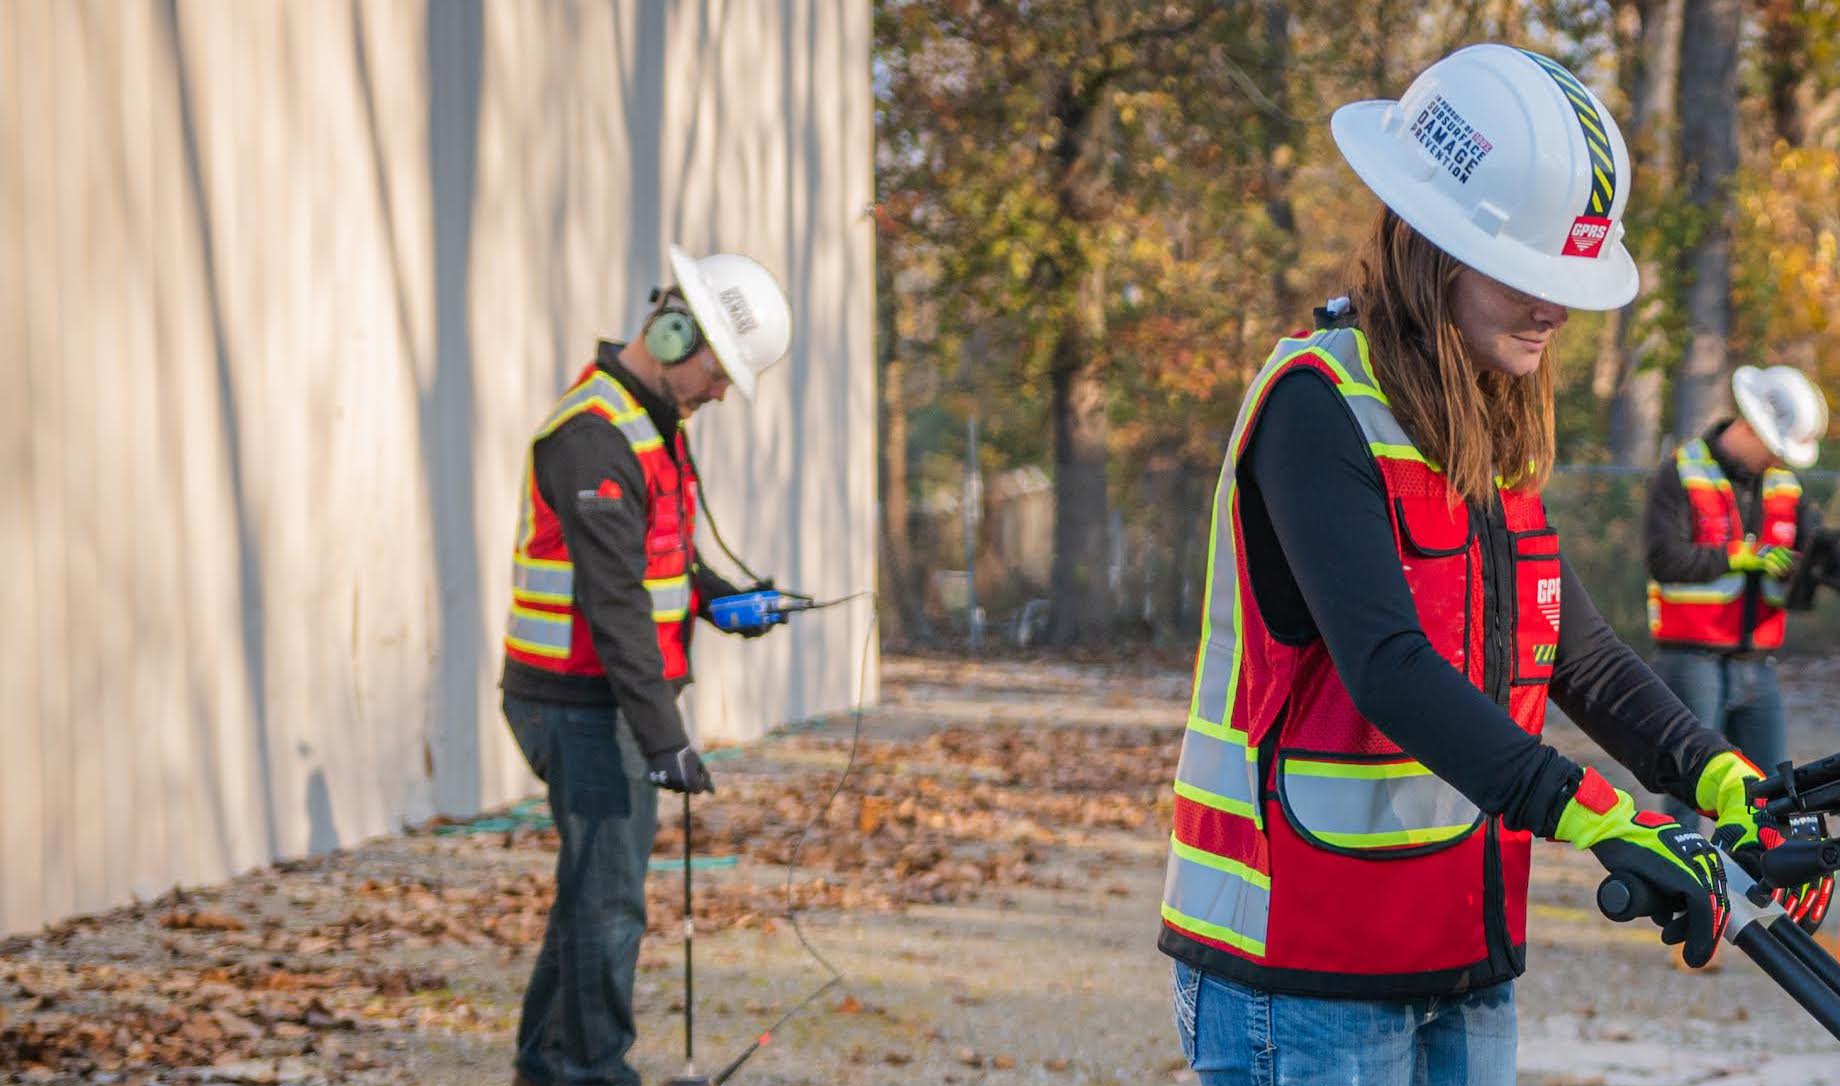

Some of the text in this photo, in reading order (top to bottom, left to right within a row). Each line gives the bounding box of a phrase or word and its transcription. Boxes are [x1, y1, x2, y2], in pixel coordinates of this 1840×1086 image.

[1411, 123, 1469, 184] PREVENTION
[1417, 109, 1479, 175] DAMAGE
[1428, 101, 1486, 161] SUBSURFACE
[1571, 223, 1607, 239] GPRS
